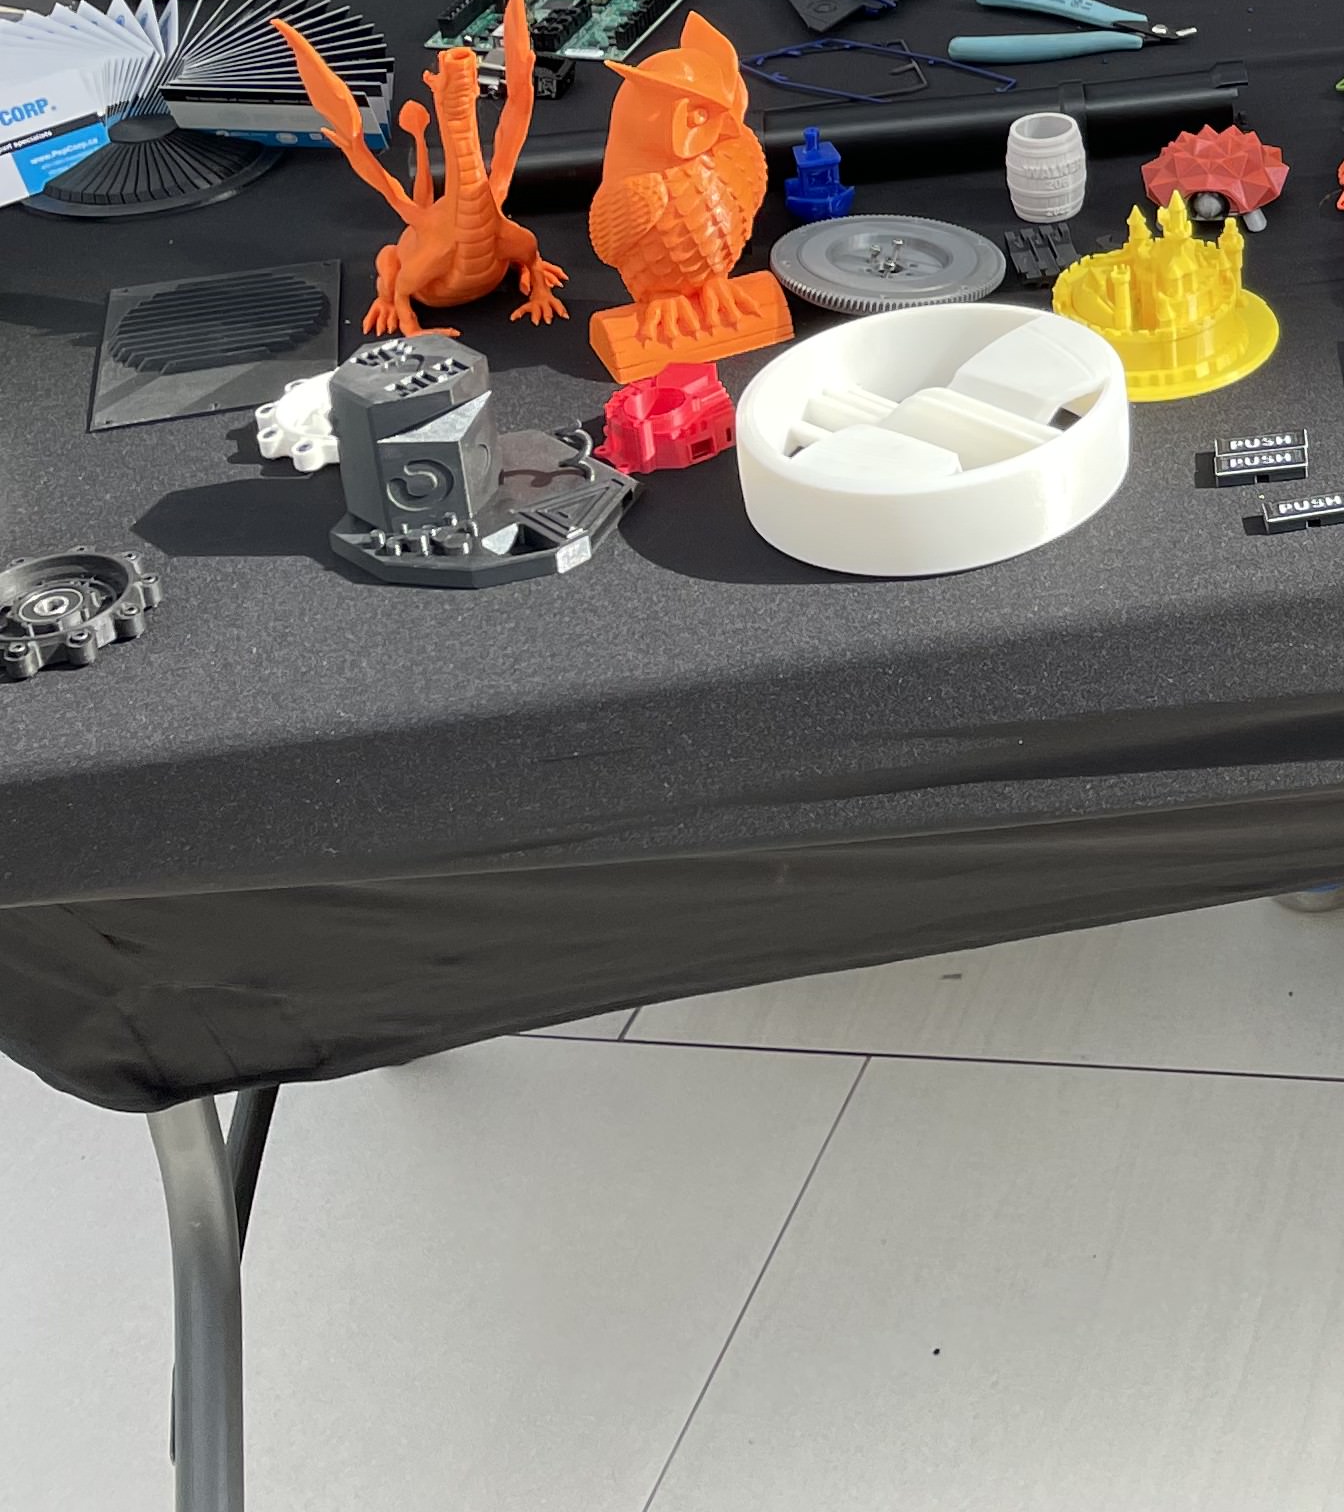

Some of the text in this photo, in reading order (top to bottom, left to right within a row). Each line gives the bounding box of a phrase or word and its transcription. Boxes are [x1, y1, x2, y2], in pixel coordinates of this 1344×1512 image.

[0, 97, 57, 127] CORP.
[1229, 435, 1292, 451] PUSH
[1229, 452, 1292, 468] PUSH
[1278, 495, 1342, 515] PUSH
